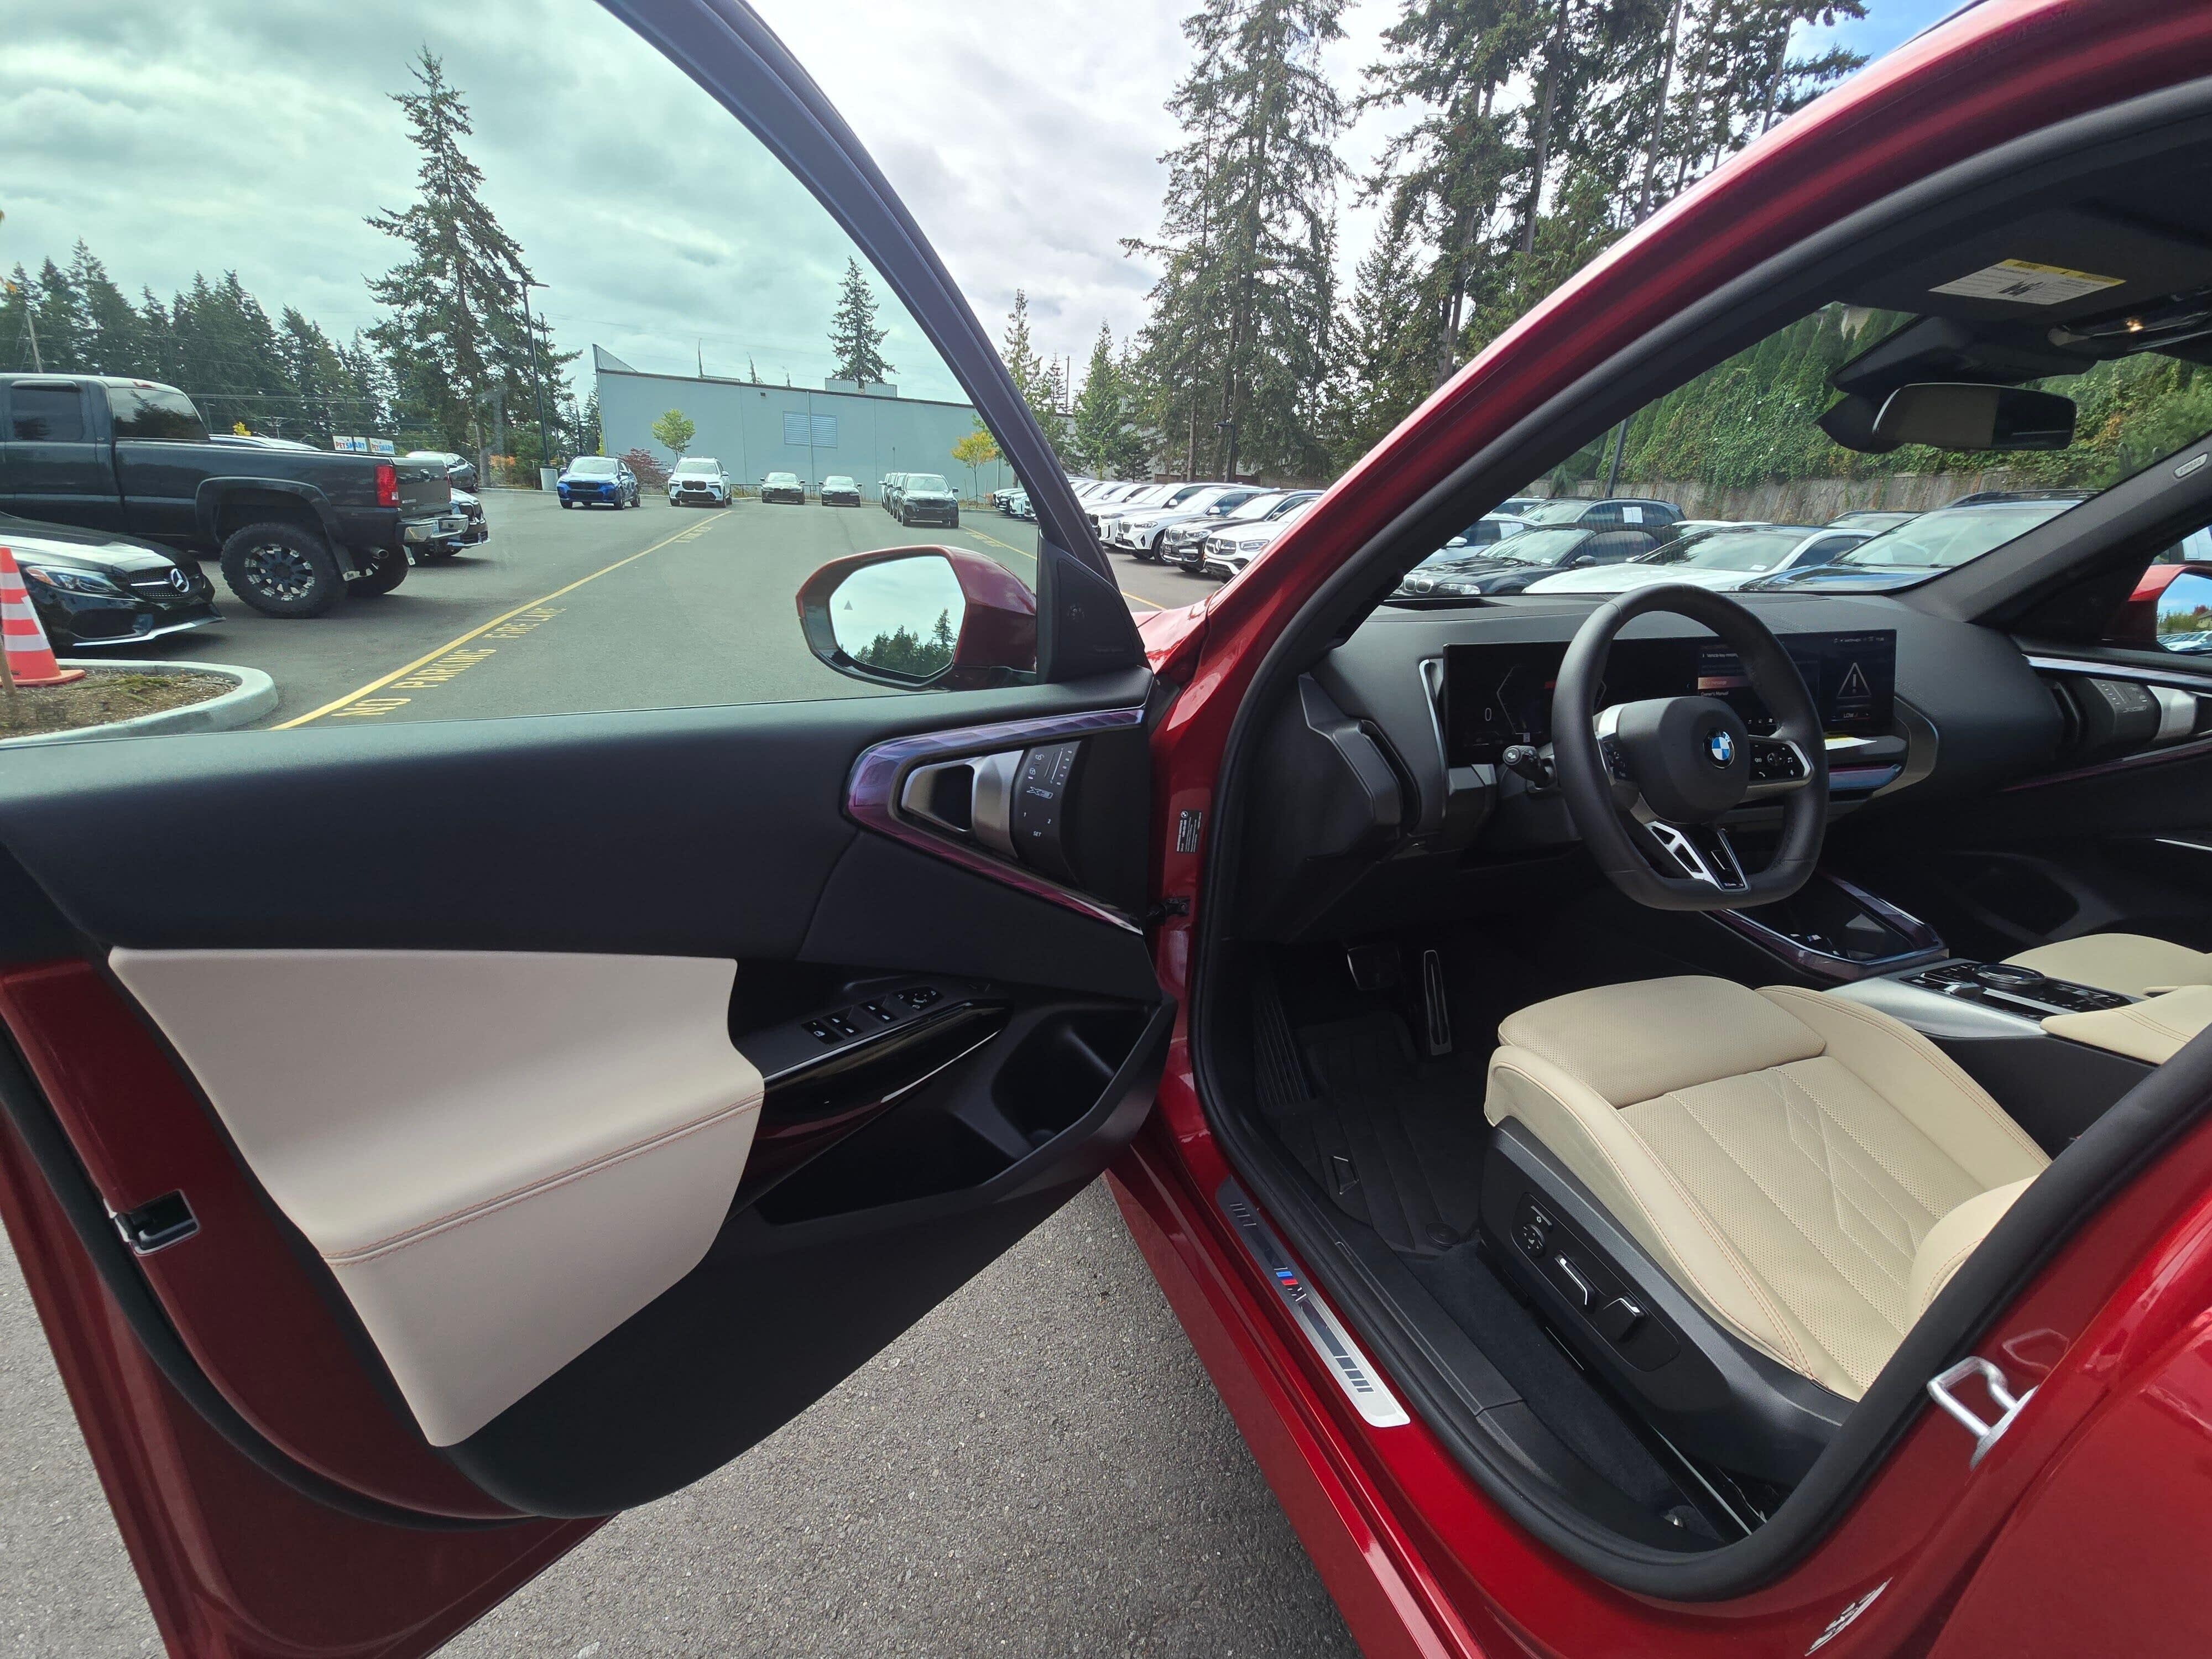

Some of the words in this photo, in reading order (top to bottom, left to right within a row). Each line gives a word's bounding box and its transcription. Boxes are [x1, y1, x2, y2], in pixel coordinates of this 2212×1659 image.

[331, 698, 411, 716] NO
[390, 649, 497, 688] PARKING
[482, 623, 540, 639] FIRE
